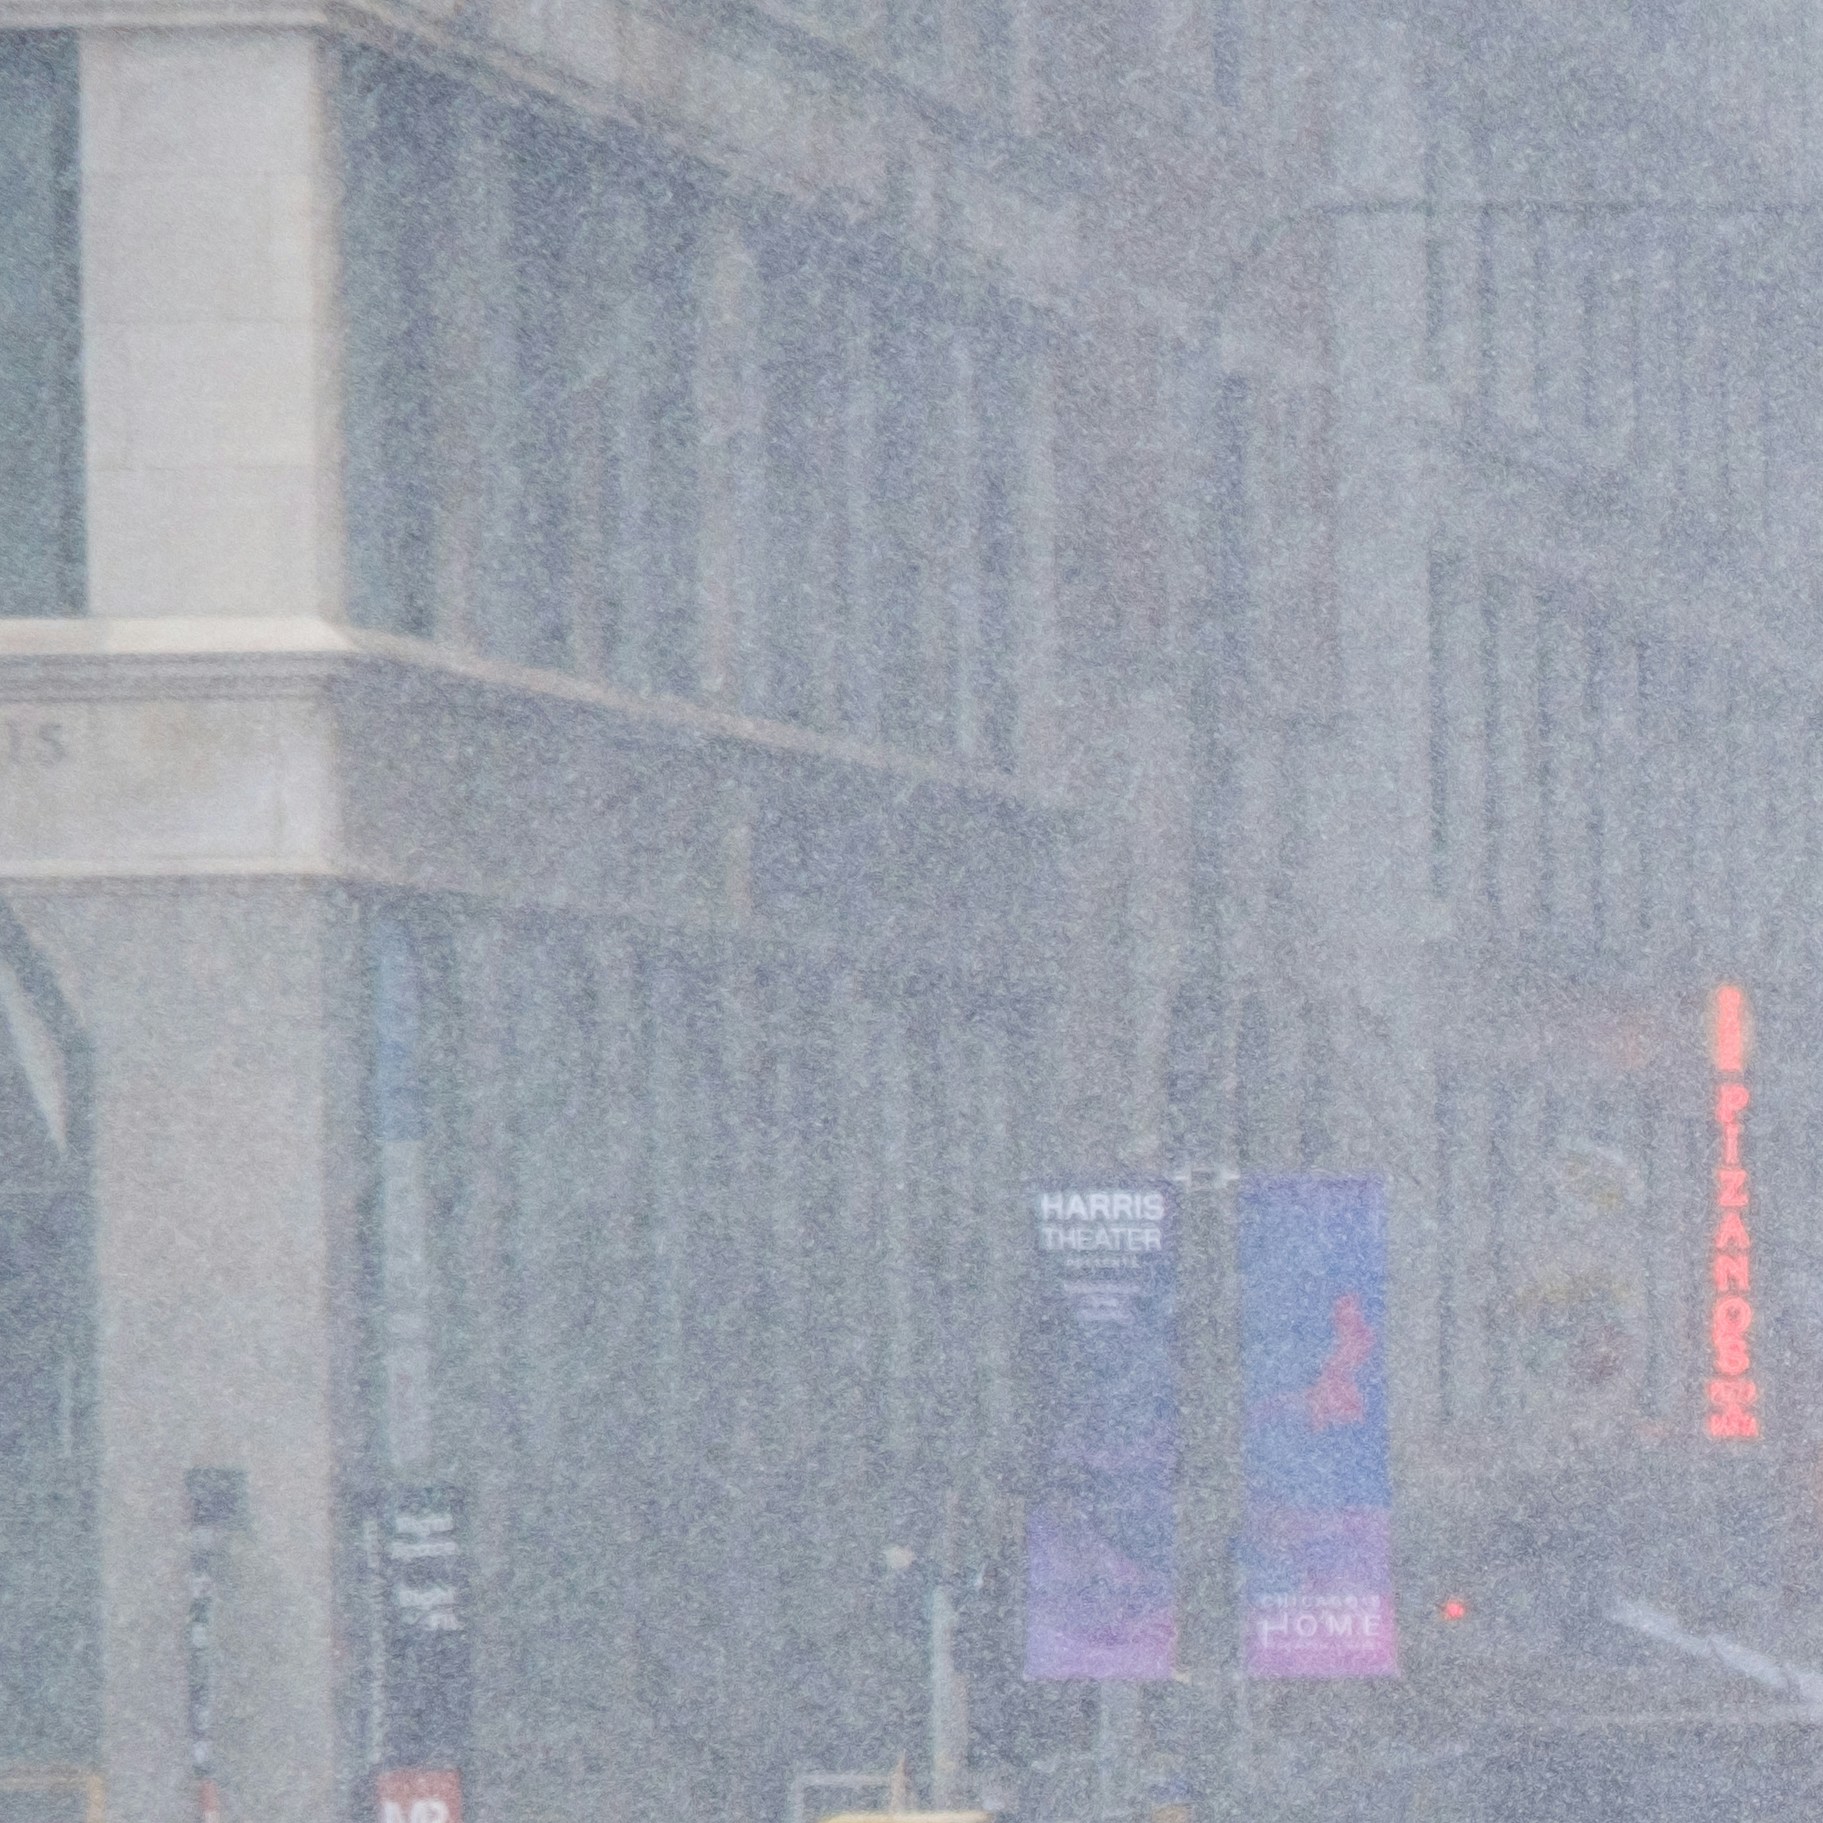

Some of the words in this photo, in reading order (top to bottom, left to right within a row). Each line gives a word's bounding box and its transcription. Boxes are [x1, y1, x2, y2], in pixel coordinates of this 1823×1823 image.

[1041, 1191, 1165, 1220] HARRIS
[1042, 1225, 1162, 1251] THEATER
[1257, 1612, 1381, 1648] HOME
